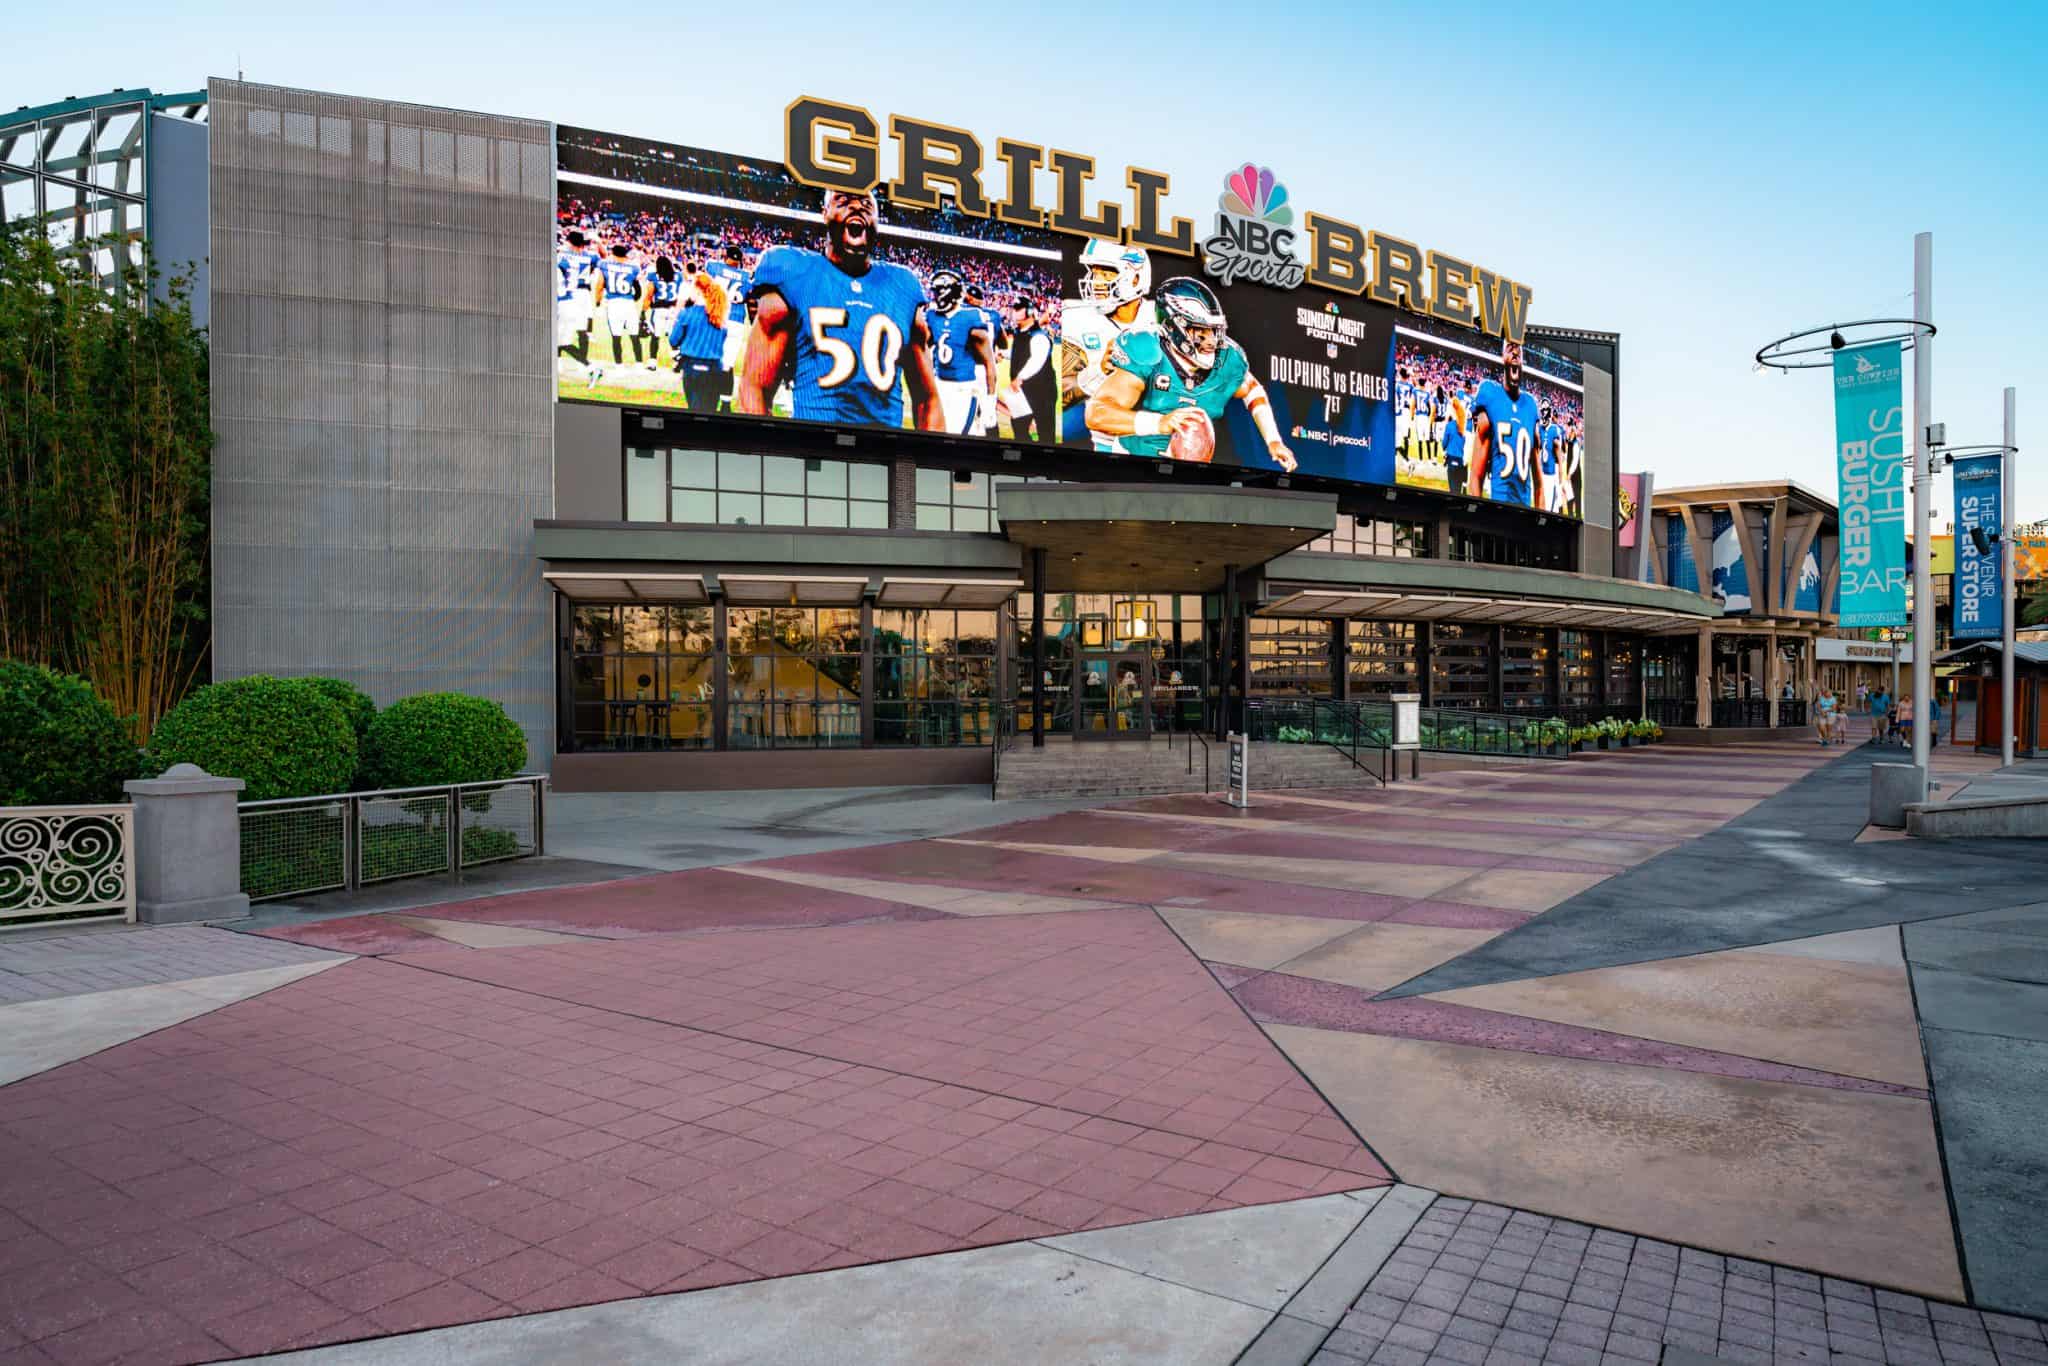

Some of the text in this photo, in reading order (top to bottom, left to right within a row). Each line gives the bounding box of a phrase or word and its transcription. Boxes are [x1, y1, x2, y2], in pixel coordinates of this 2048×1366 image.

[784, 95, 1196, 256] GRILL
[1206, 237, 1304, 287] Sports
[1220, 214, 1295, 261] NBC
[1305, 211, 1533, 344] BREW
[938, 333, 953, 364] 6
[1297, 307, 1366, 340] SUNDAY NIGHT
[1306, 327, 1358, 347] FOOTBALL
[809, 307, 902, 392] 50
[1271, 355, 1331, 391] DOLPHINS
[1350, 370, 1390, 402] EAGLES
[1307, 430, 1369, 448] NBC peacock
[1497, 422, 1531, 481] 50
[1869, 406, 1904, 523] SUSHI
[1841, 440, 1872, 568] BURGER
[1980, 493, 1996, 599] THE SVENIR
[1840, 567, 1906, 595] BAR
